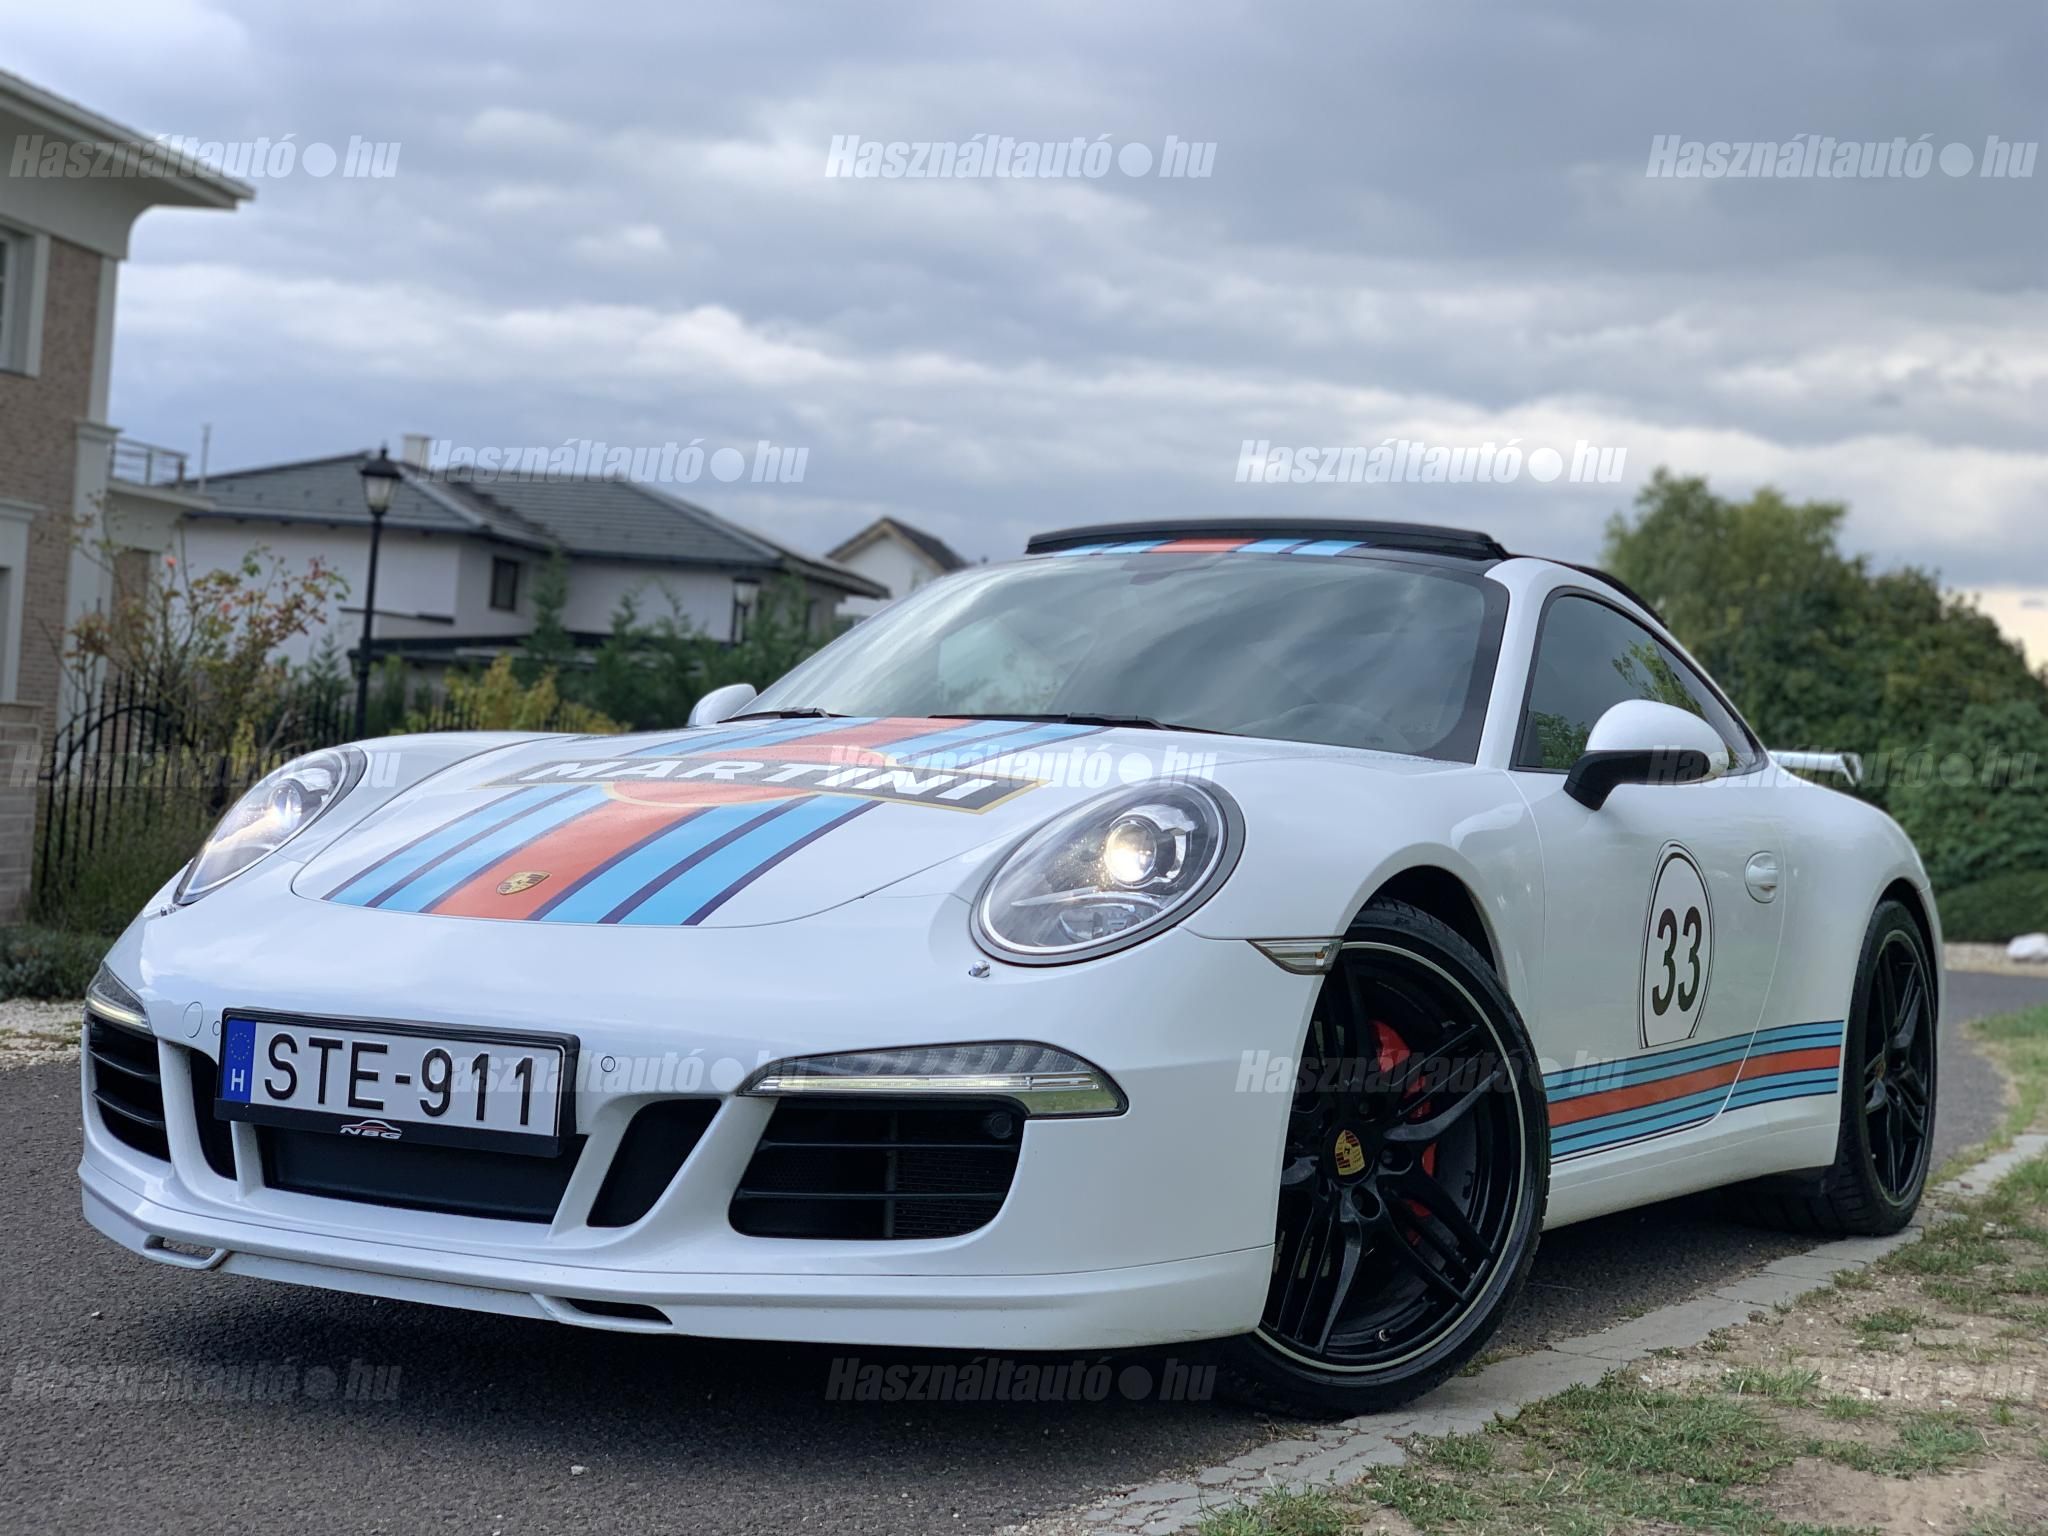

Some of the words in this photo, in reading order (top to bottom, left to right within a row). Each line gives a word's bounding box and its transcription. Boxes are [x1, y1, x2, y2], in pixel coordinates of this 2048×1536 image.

[518, 761, 998, 801] MARTINI
[1652, 906, 1702, 1016] 33
[230, 1068, 245, 1092] H
[264, 1032, 533, 1126] STE-911
